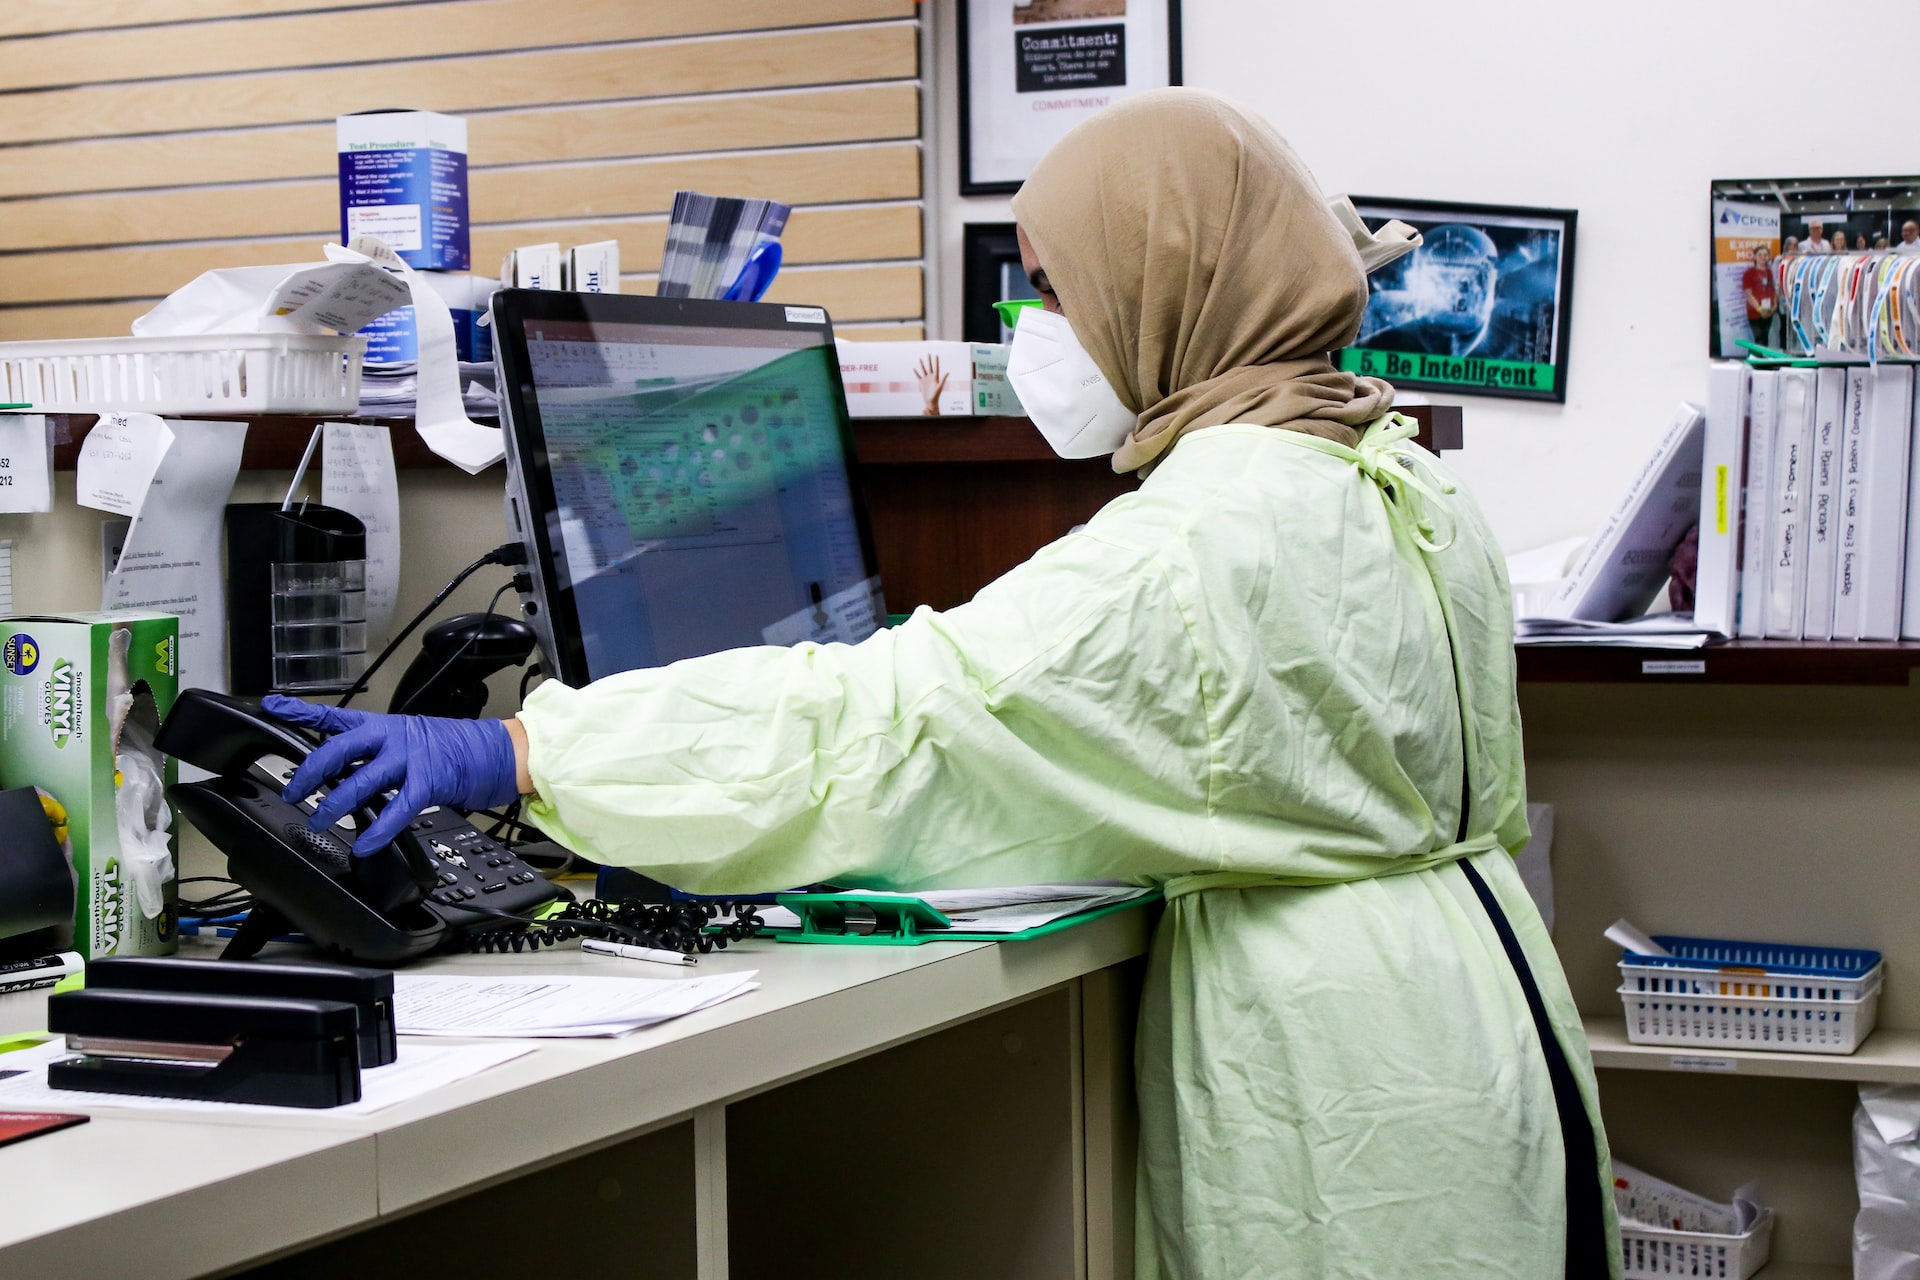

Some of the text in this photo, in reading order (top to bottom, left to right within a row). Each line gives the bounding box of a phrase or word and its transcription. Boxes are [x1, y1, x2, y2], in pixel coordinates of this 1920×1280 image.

[1055, 52, 1073, 62] you
[1032, 96, 1110, 112] COMMITMENT
[349, 140, 416, 150] Test Procedure
[1741, 215, 1778, 228] CPESN
[840, 364, 879, 372] DER-FREE
[1360, 352, 1537, 388] 5. Be Intelligent
[7, 638, 16, 673] SUNSET
[44, 681, 52, 725] GLOVES
[53, 665, 71, 742] VINYL
[103, 865, 118, 955] VINYL
